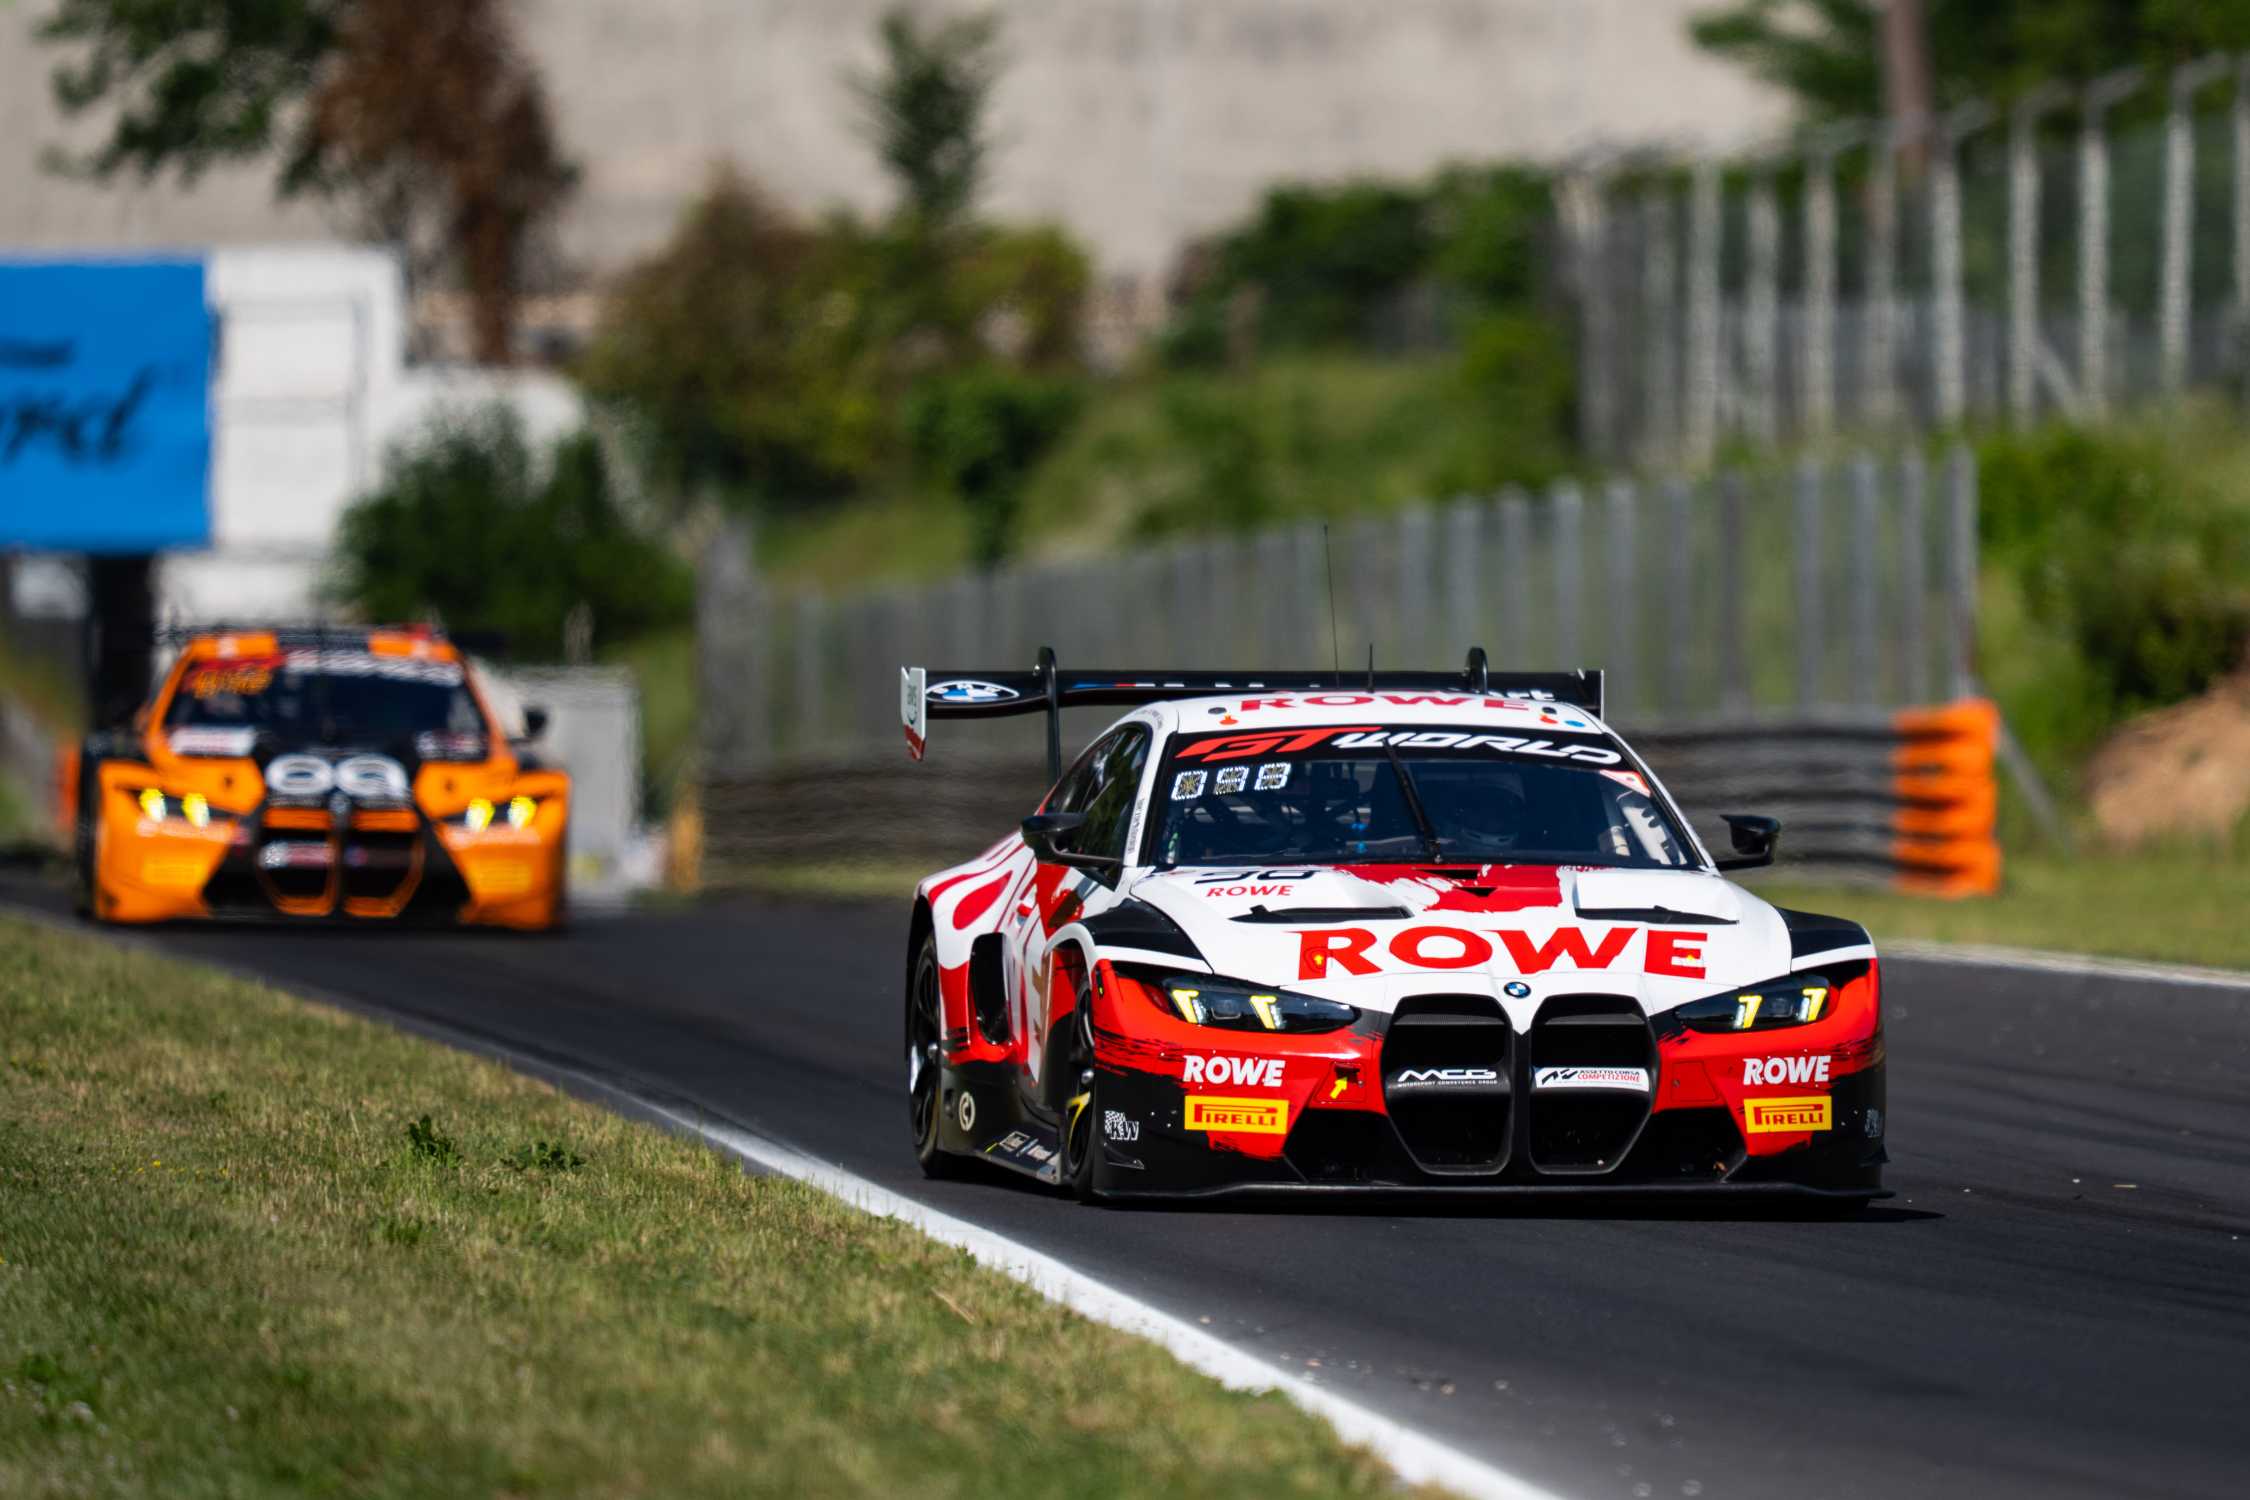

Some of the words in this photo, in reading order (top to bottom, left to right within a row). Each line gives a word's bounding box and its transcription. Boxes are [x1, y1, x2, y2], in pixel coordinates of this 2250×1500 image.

[1240, 694, 1529, 711] ROWE
[1175, 727, 1383, 762] GT
[1332, 732, 1621, 764] WORLD
[1206, 885, 1293, 897] ROWE
[1284, 926, 1708, 980] ROWE
[1183, 1055, 1286, 1087] ROWE
[1742, 1055, 1831, 1085] ROWE
[1194, 1103, 1278, 1127] PIRELLI
[1753, 1103, 1824, 1125] PIRELLI
